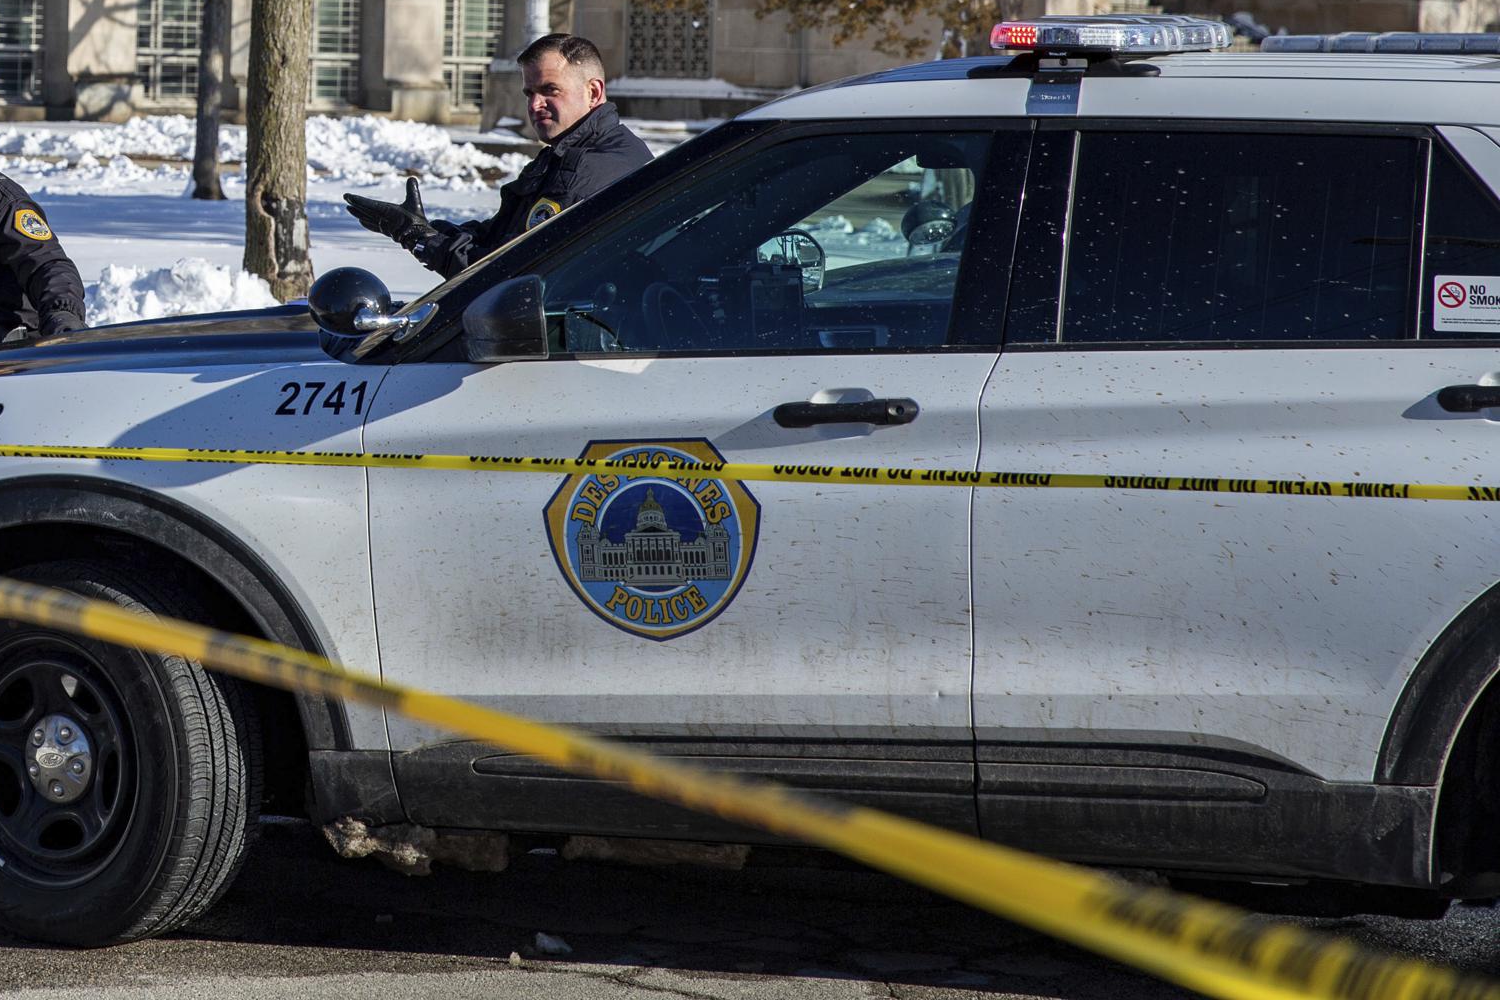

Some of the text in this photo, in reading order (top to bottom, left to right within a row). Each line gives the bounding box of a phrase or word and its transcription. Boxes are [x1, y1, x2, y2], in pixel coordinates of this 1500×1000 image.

[1469, 284, 1486, 295] NO
[275, 381, 368, 415] 2741
[571, 473, 620, 527] DES
[605, 586, 708, 624] POLICE
